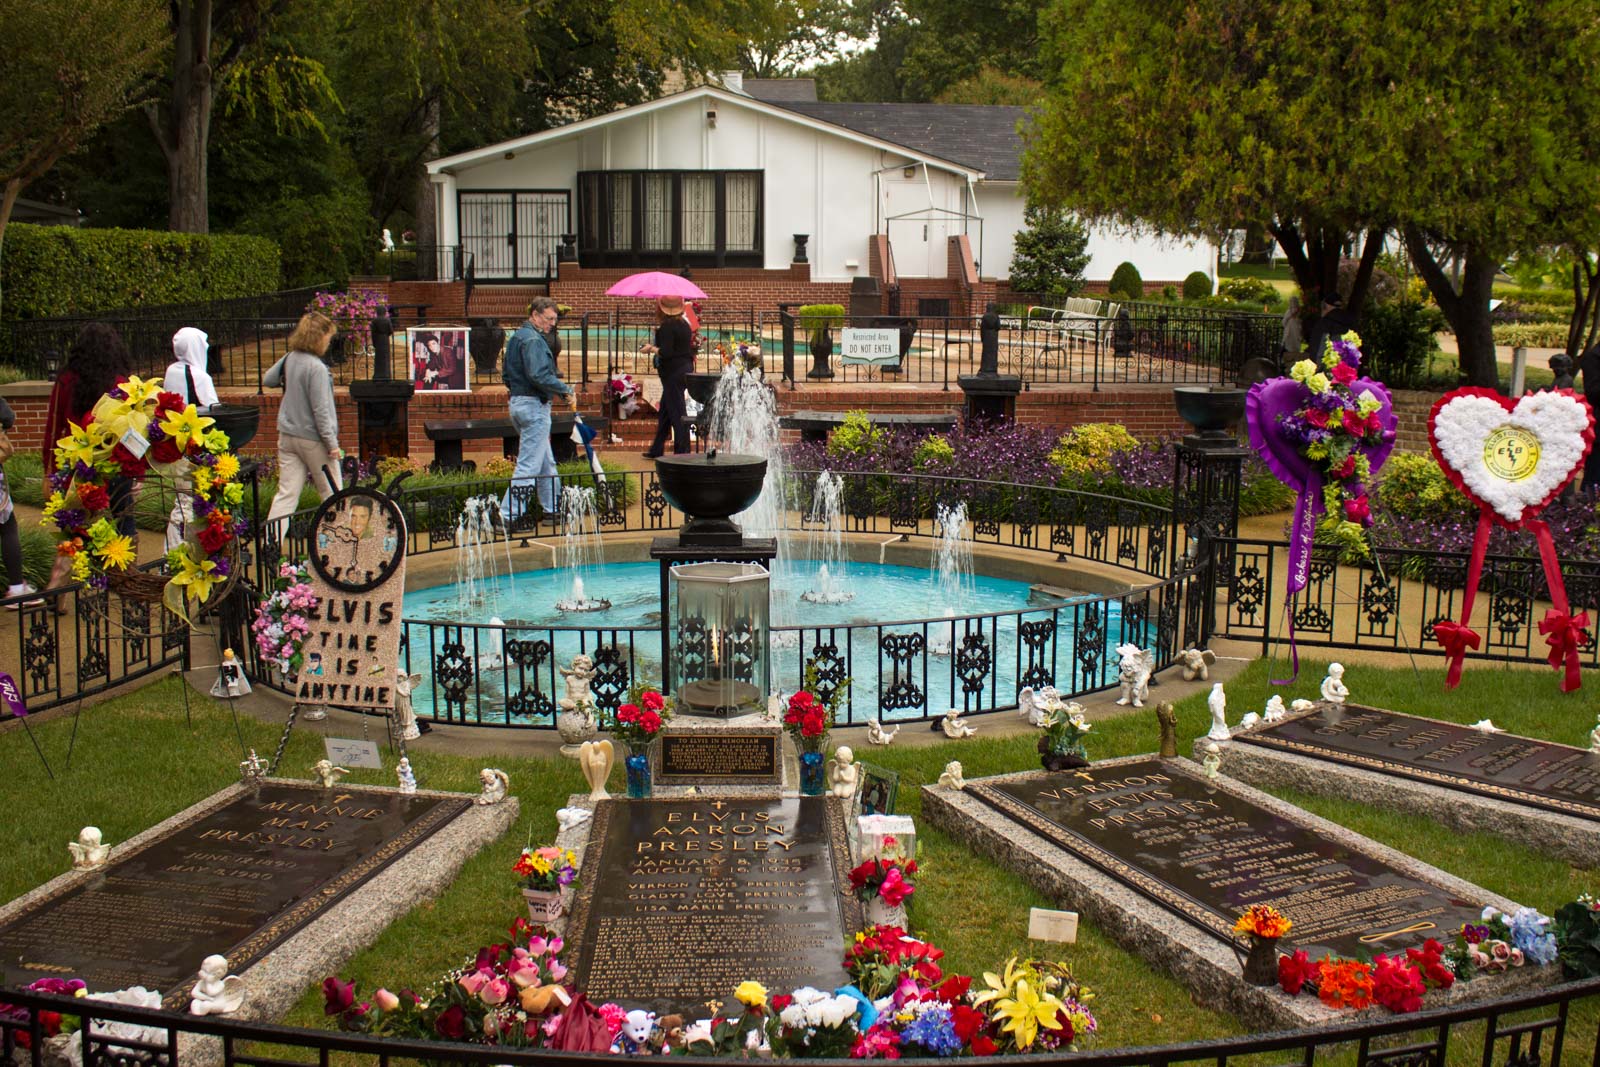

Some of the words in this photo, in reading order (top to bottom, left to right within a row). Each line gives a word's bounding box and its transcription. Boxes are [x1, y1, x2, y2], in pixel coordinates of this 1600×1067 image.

[853, 332, 876, 341] Restricted
[850, 344, 858, 354] DO
[860, 344, 872, 354] NOT
[874, 344, 892, 354] ENTER
[308, 597, 394, 624] ELVIS
[320, 632, 378, 652] TIME
[336, 658, 359, 676] IS
[299, 682, 390, 704] ANYTIME
[1039, 772, 1172, 800] VERNON
[1088, 789, 1174, 812] ELVIS
[259, 801, 384, 820] MINNIE
[667, 812, 770, 823] ELVIS
[1088, 798, 1221, 830] PRESLEY
[261, 817, 335, 832] MAE
[654, 825, 786, 836] AARON
[199, 828, 350, 851] PRESLEY
[636, 840, 798, 853] PRESLEY
[1224, 836, 1268, 849] PRESLEY
[1249, 841, 1294, 854] PRESLEY
[184, 852, 231, 862] JUNE
[632, 858, 727, 868] JANUARY
[165, 864, 210, 872] MAY
[230, 870, 273, 880] 1980
[632, 866, 714, 876] AUGUST
[1196, 868, 1230, 880] ELVIS
[1273, 852, 1318, 864] PRESLEY
[1292, 858, 1337, 872] PRESLEY
[1306, 870, 1352, 884] PRESLEY
